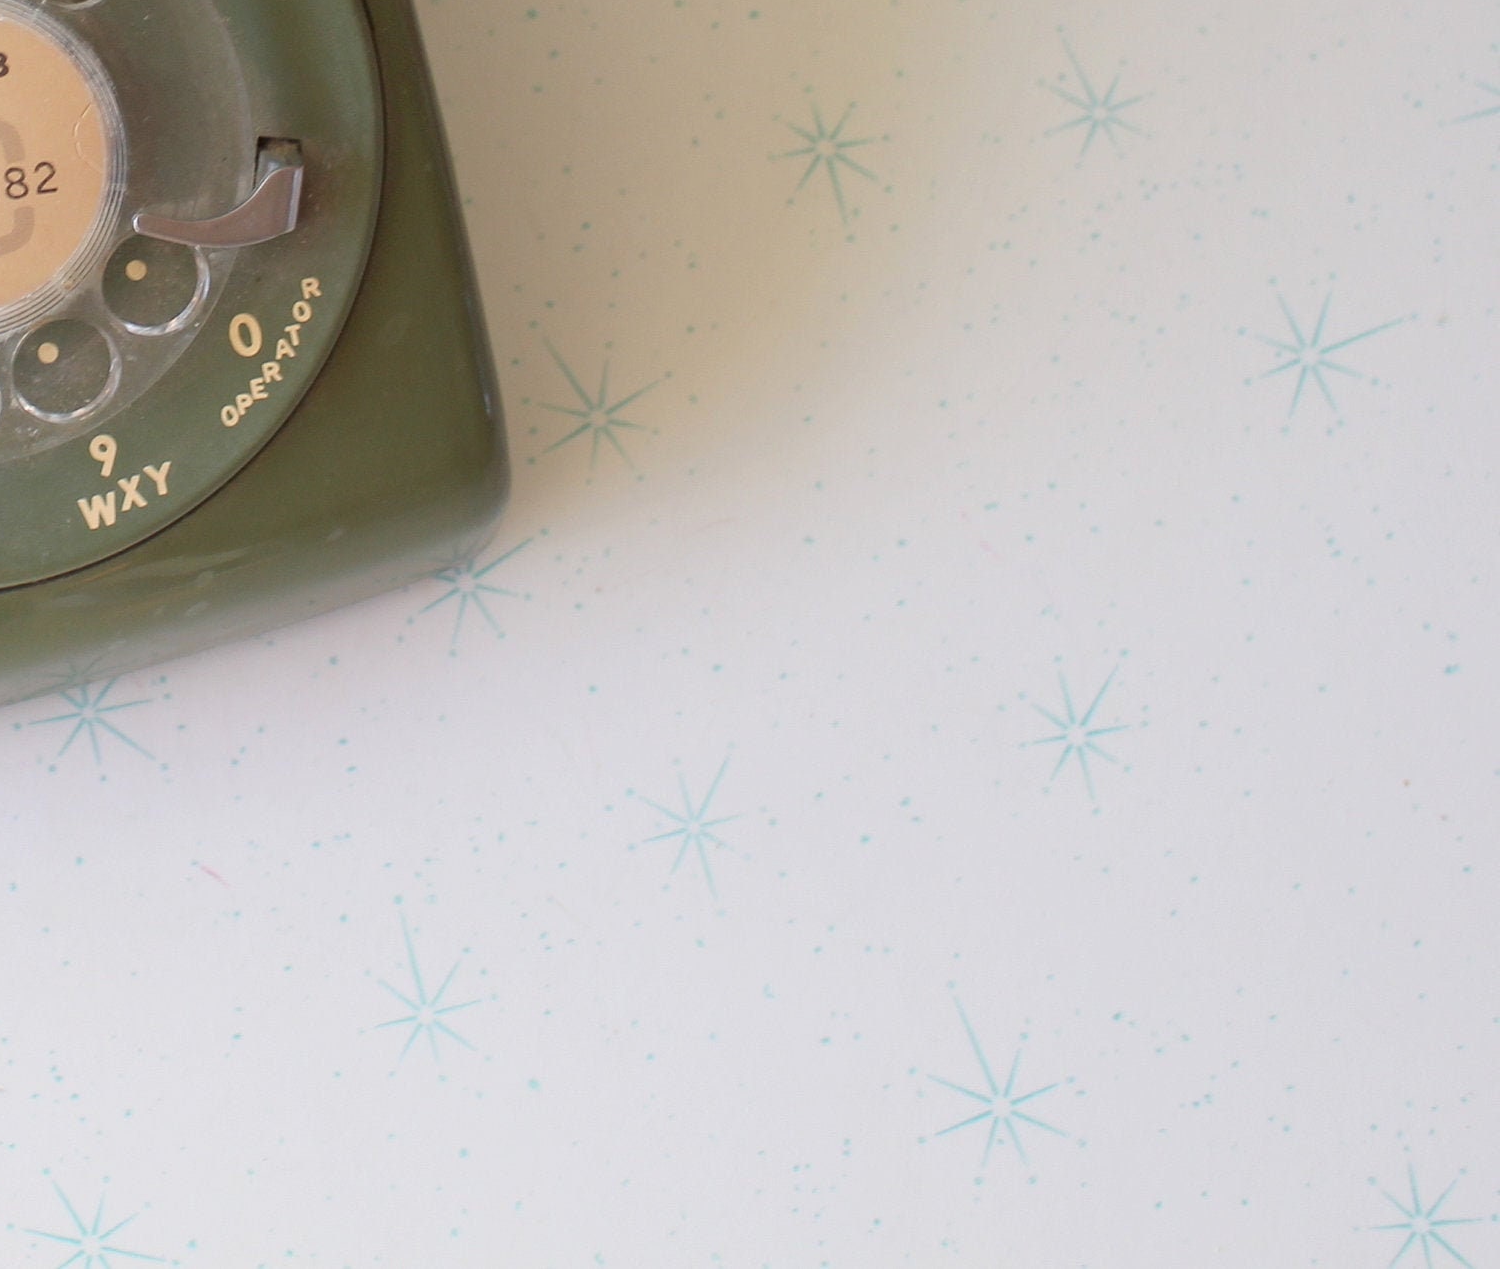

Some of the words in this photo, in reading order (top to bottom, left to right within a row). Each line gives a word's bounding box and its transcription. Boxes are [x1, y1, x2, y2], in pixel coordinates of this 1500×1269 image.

[221, 277, 322, 427] OPERATOR
[88, 434, 119, 477] 9
[77, 461, 172, 530] WXY
